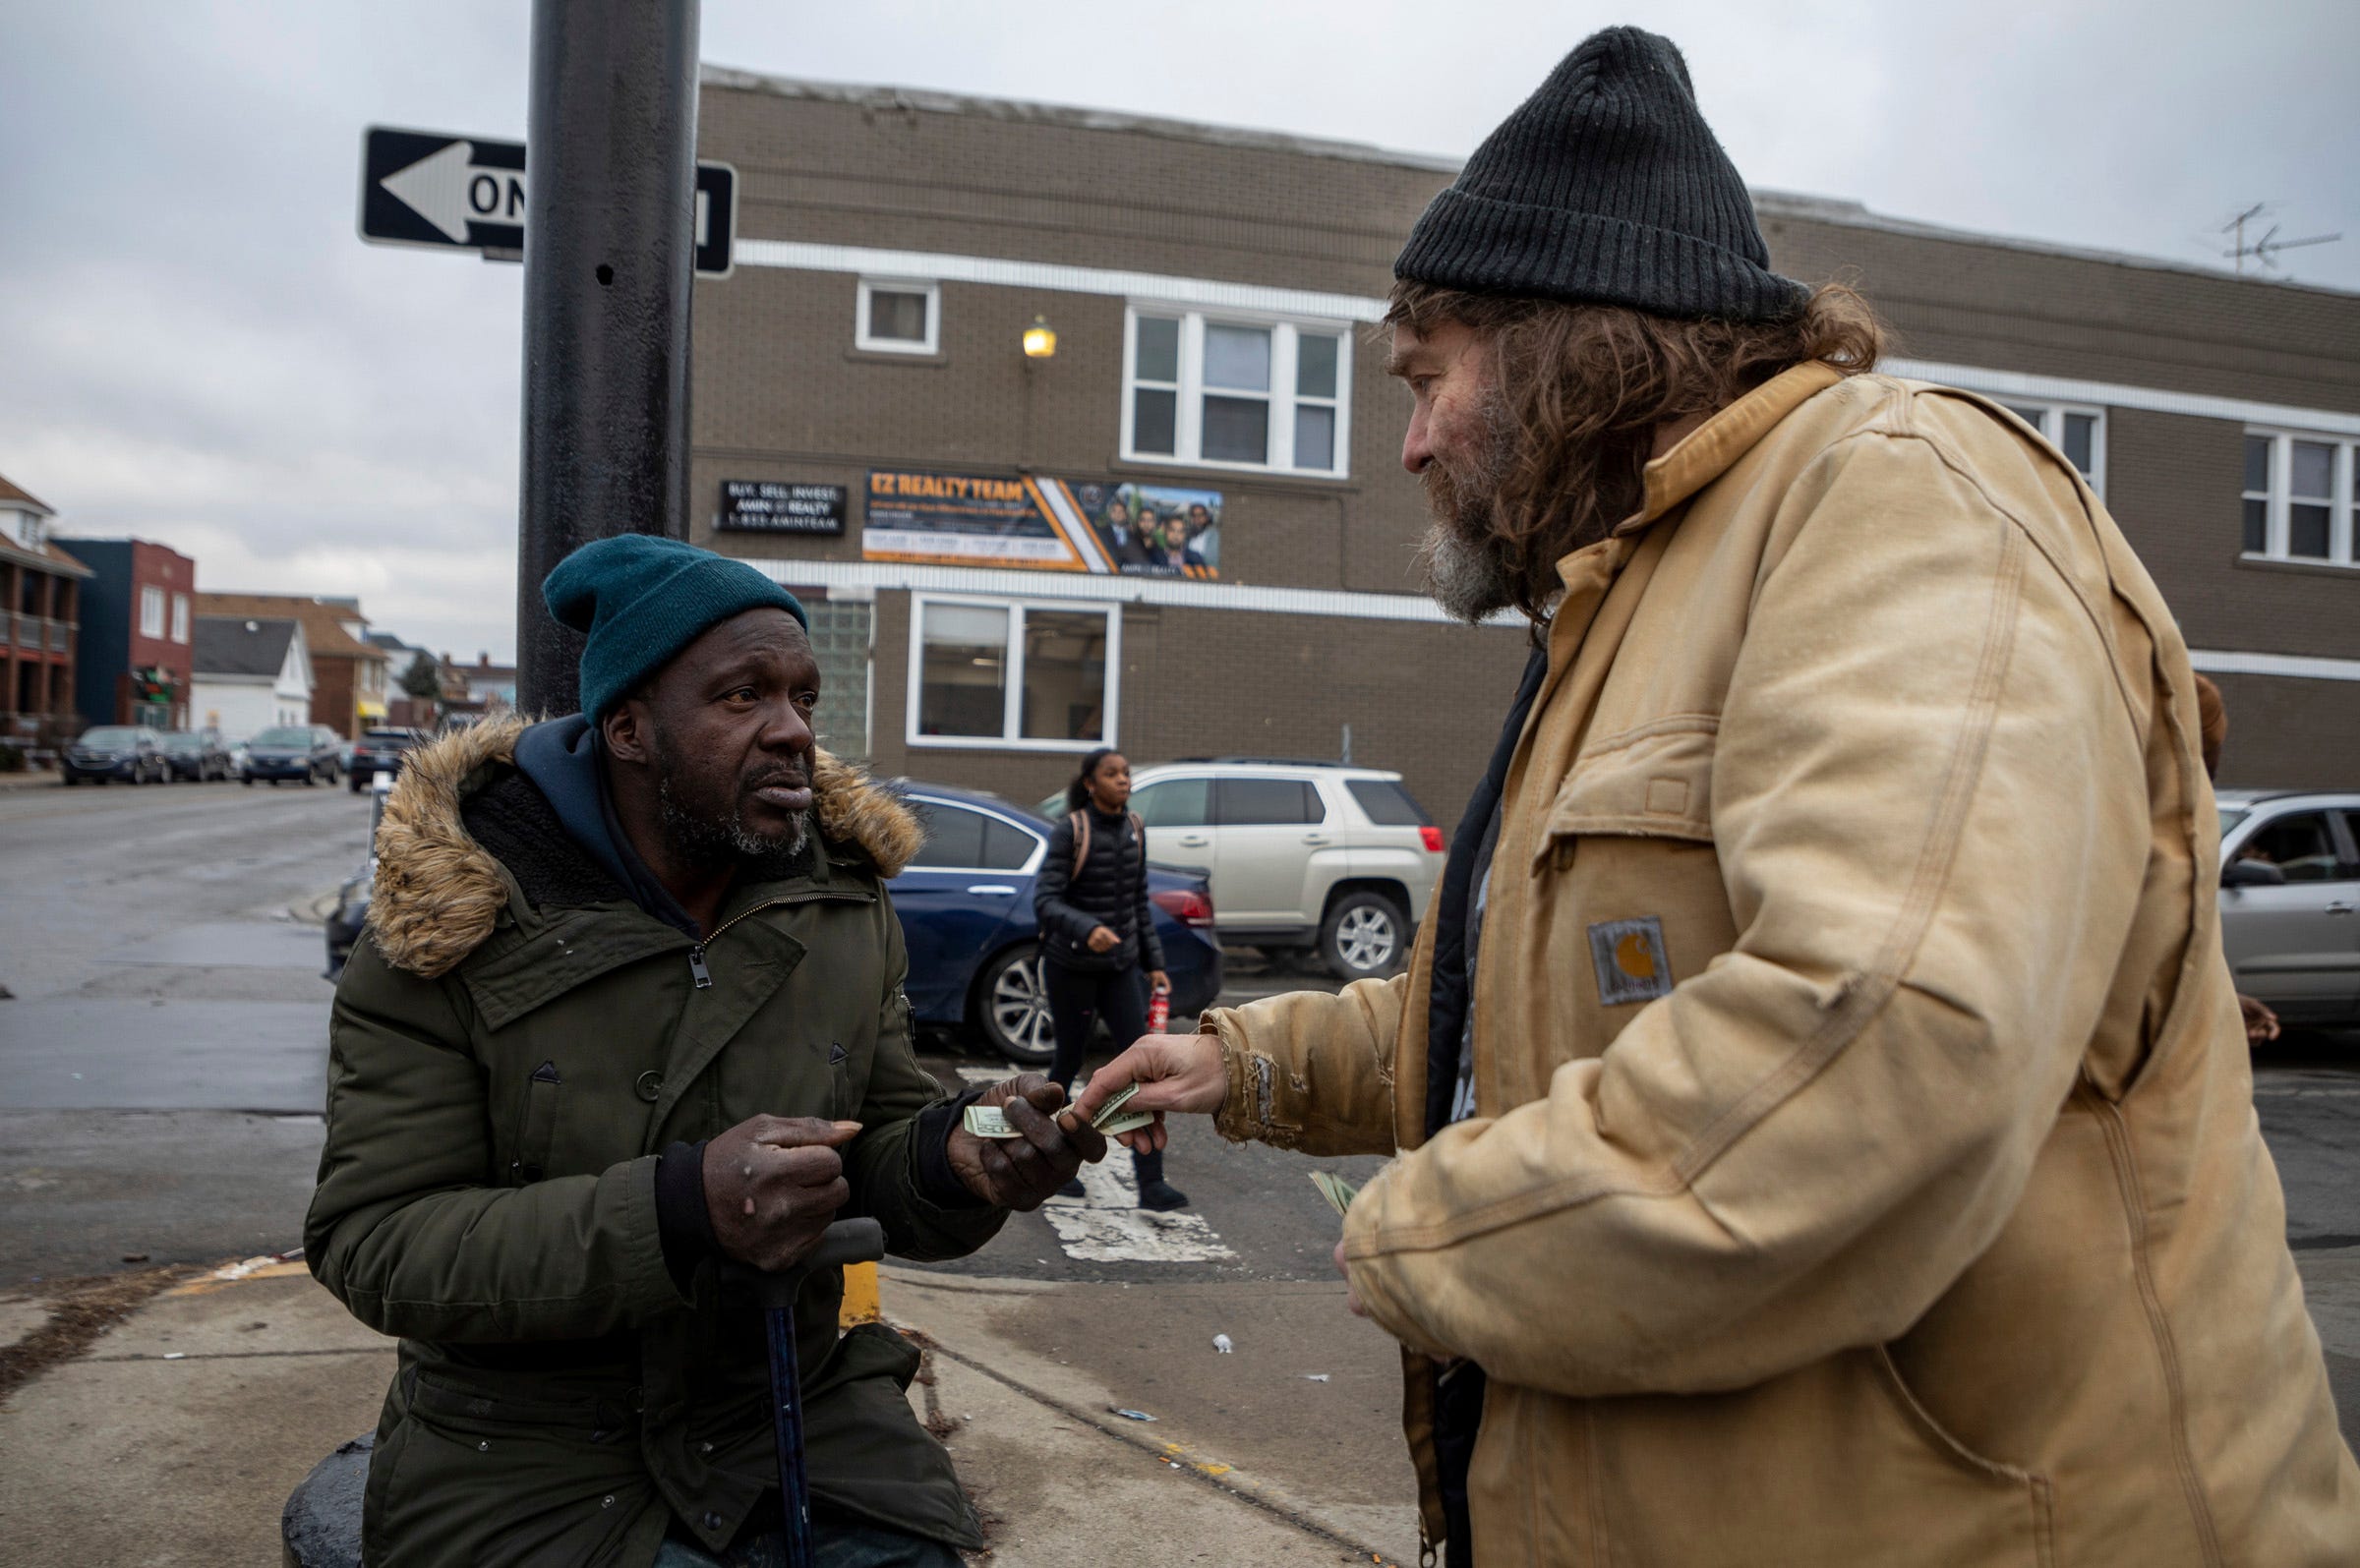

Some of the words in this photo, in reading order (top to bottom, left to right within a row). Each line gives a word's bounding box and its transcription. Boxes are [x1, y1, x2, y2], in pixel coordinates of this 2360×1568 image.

[469, 174, 525, 218] ON
[871, 472, 895, 494] EZ
[897, 473, 967, 498] REALTY
[971, 478, 1024, 502] TEAM
[737, 498, 772, 511] AMIN
[788, 500, 830, 515] REALTY
